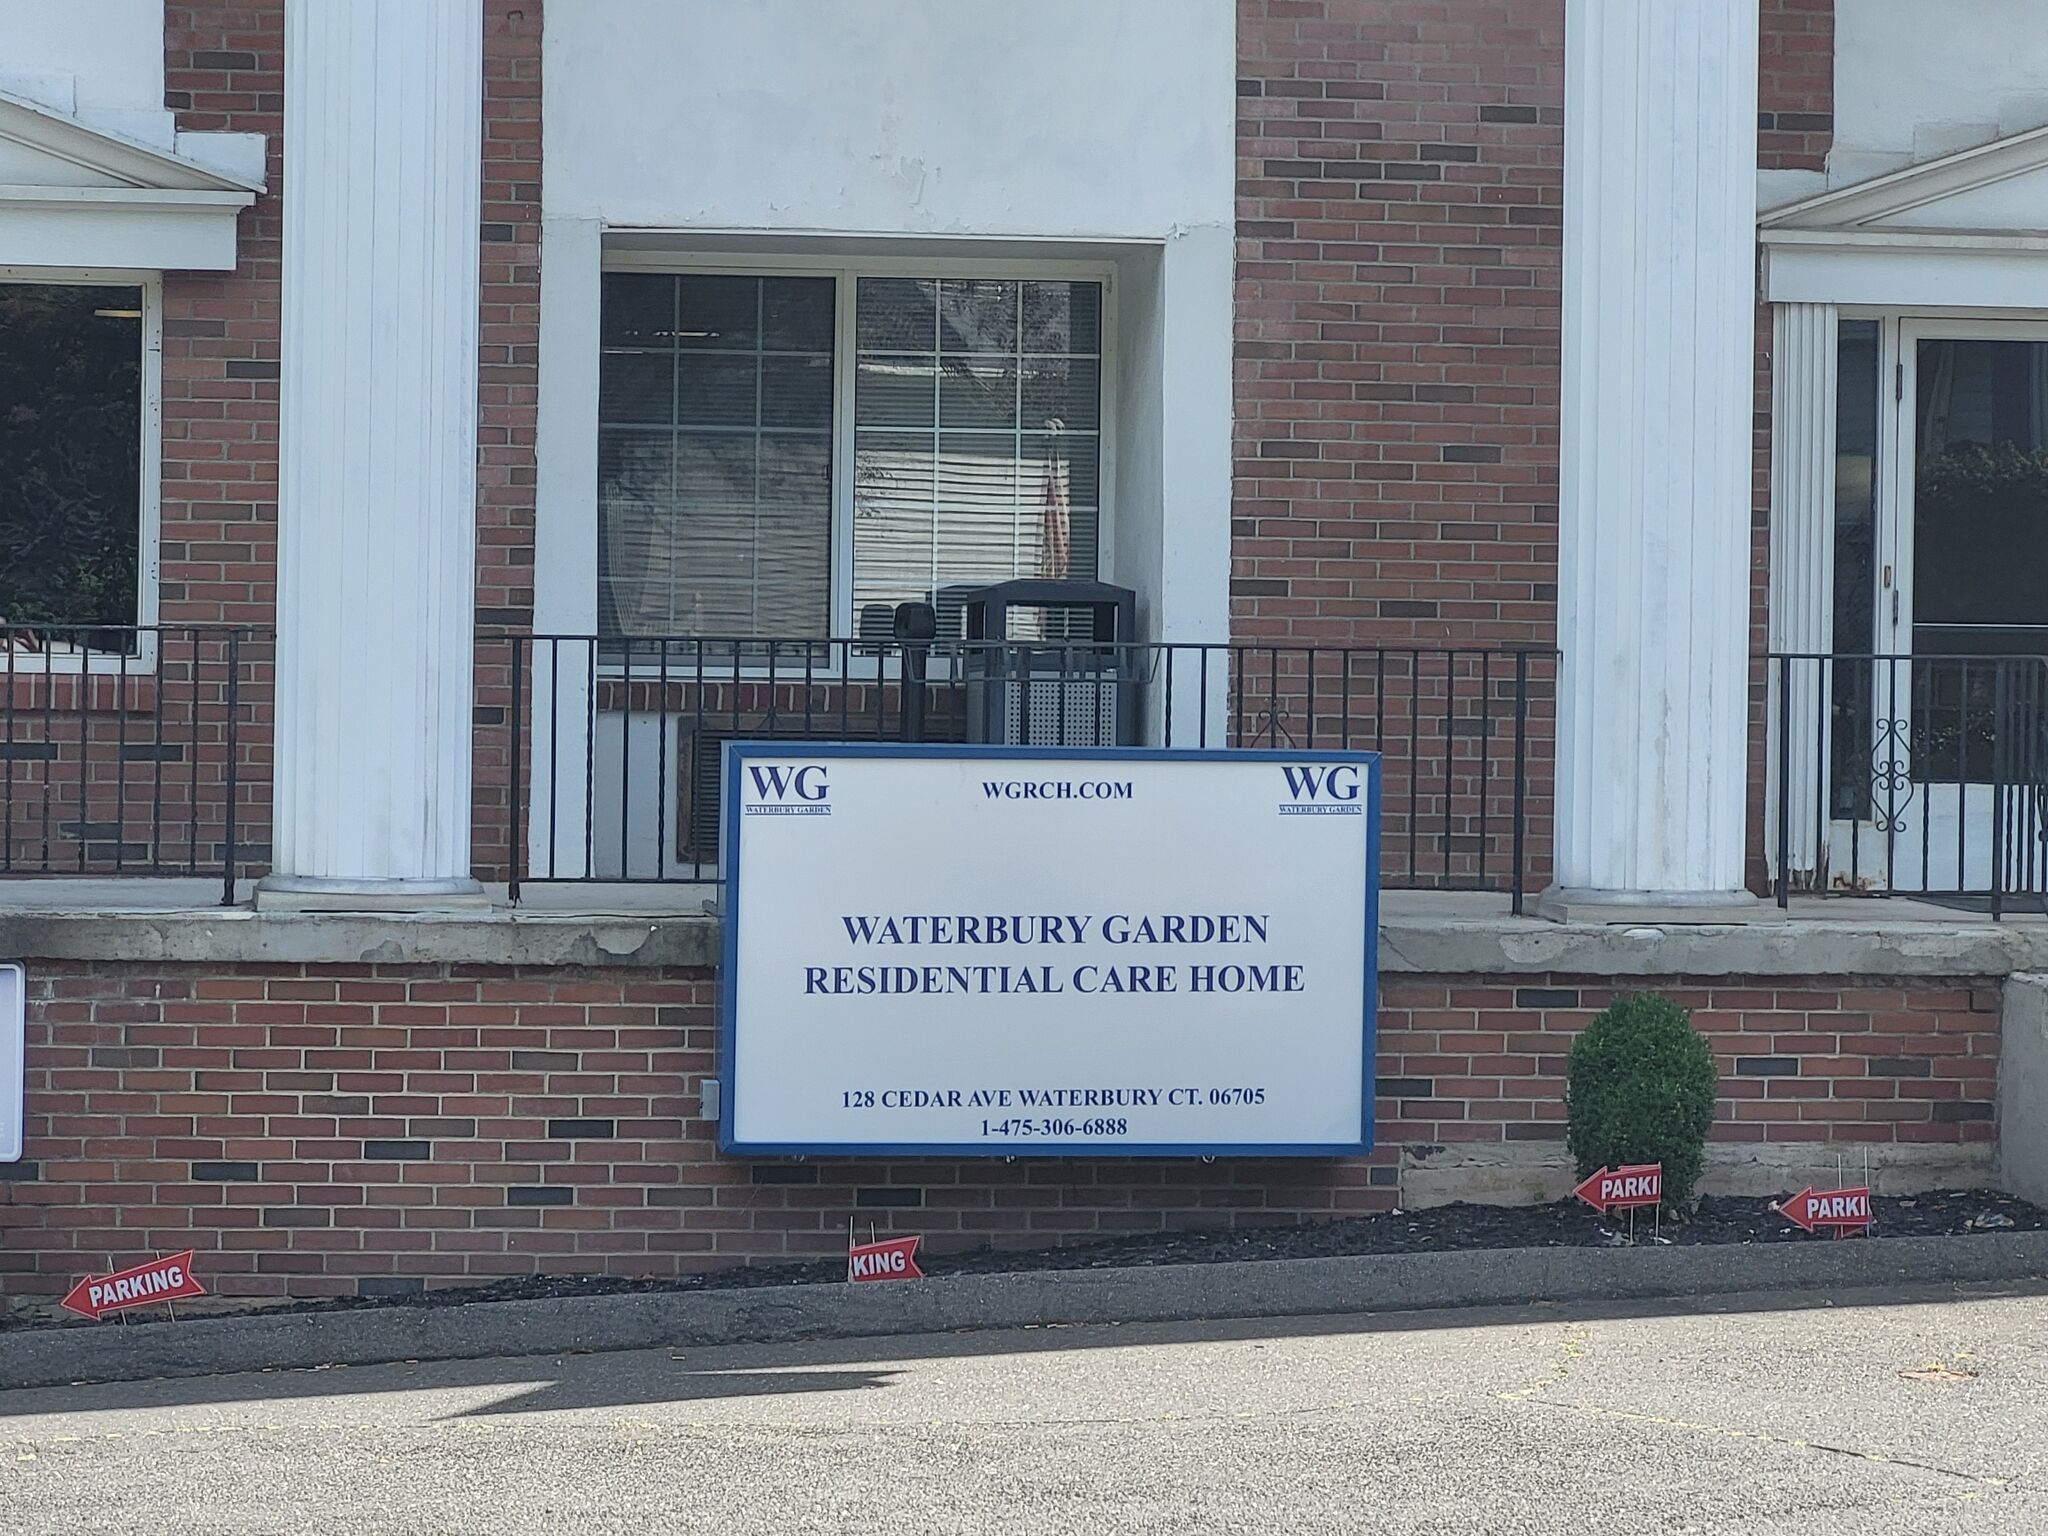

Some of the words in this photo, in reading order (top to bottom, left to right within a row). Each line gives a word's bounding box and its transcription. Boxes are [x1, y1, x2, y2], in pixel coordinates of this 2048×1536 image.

[748, 765, 831, 801] WG
[982, 781, 1133, 800] WGRCH.COM
[1281, 766, 1361, 801] WG
[746, 806, 795, 814] WATERBURY
[797, 806, 831, 814] GARDEN
[1279, 805, 1327, 814] WATERBURY
[1329, 805, 1362, 814] GARDEN
[842, 915, 1093, 945] WATERBURY
[1102, 914, 1270, 944] GARDEN
[804, 965, 1064, 995] RESIDENTIAL
[1072, 965, 1178, 994] CARE
[1188, 964, 1305, 993] HOME
[843, 1090, 875, 1108] 128
[881, 1090, 964, 1107] CEDAR
[967, 1090, 1012, 1107] AVE
[1018, 1089, 1163, 1107] WATERBURY
[1168, 1089, 1203, 1106] CT.
[1209, 1088, 1265, 1106] 06705
[982, 1117, 1128, 1136] 1-475-306-6888
[853, 1250, 906, 1277] KING
[88, 1266, 185, 1306] PARKING
